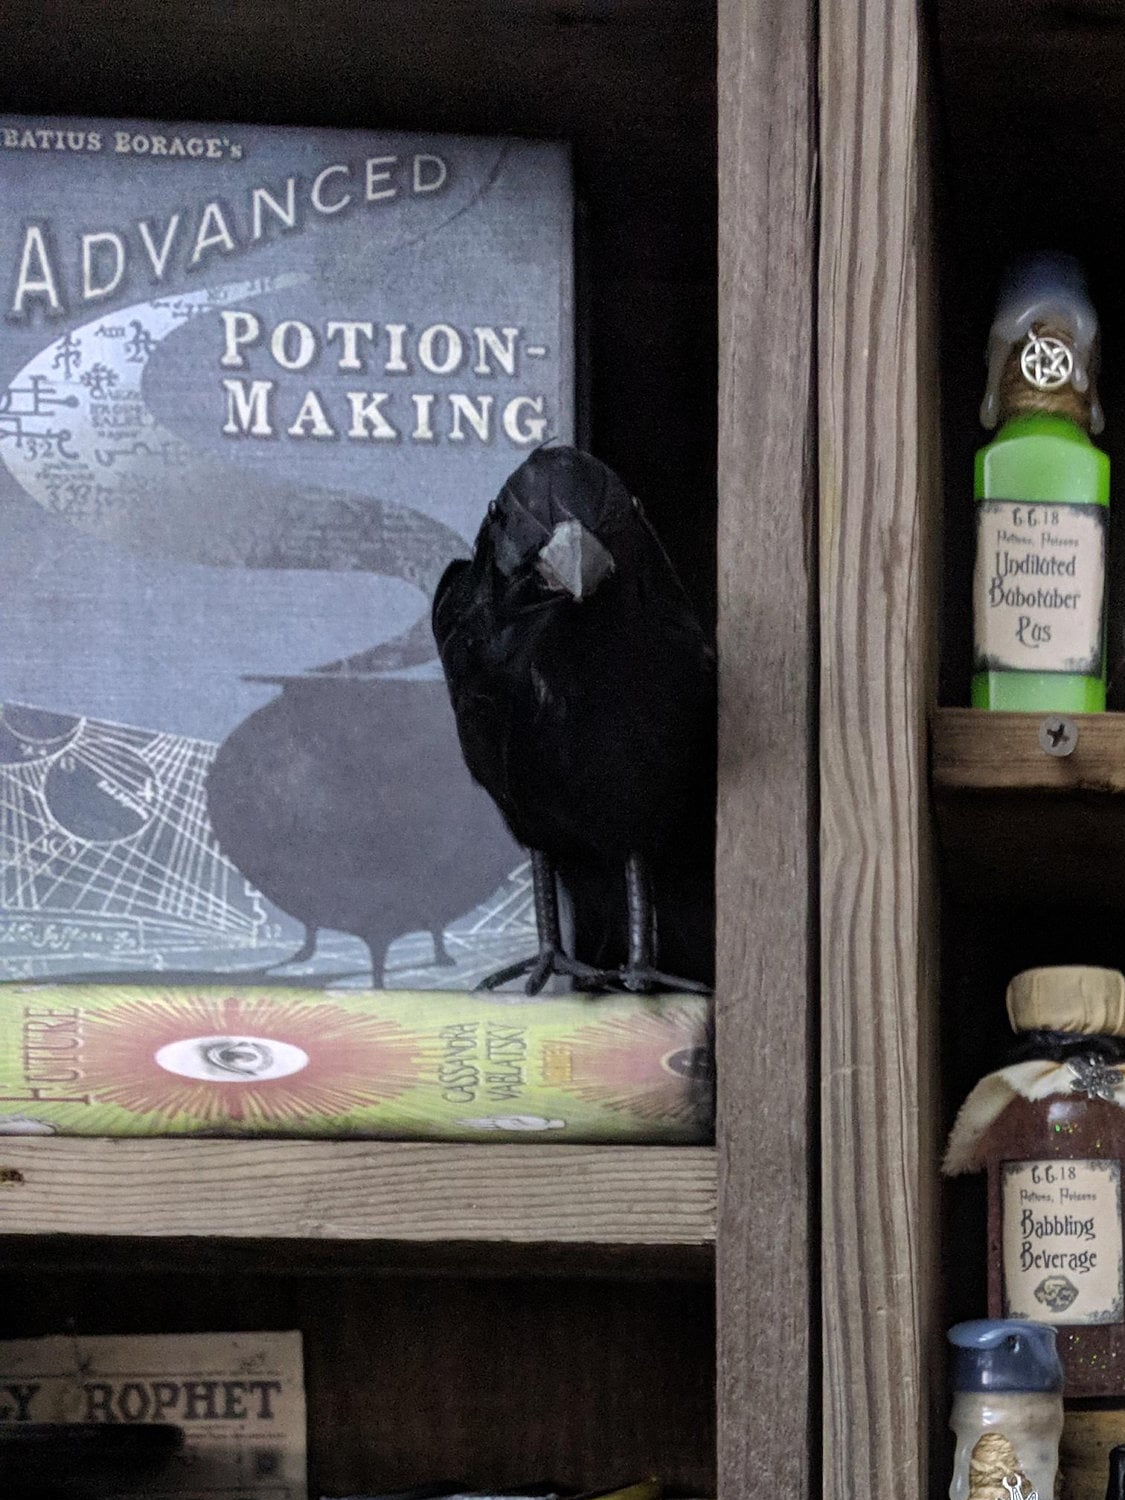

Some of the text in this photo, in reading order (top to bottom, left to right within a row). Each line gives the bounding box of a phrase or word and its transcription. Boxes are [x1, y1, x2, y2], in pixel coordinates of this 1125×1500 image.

[12, 153, 450, 312] ADVANCED
[219, 309, 547, 377] POTION-
[221, 379, 549, 442] MAKING
[438, 1020, 480, 1103] CASSANDRA
[485, 1020, 527, 1101] VABLATSKY
[1020, 1209, 1096, 1241] Babbling
[1020, 1241, 1097, 1274] Beverage
